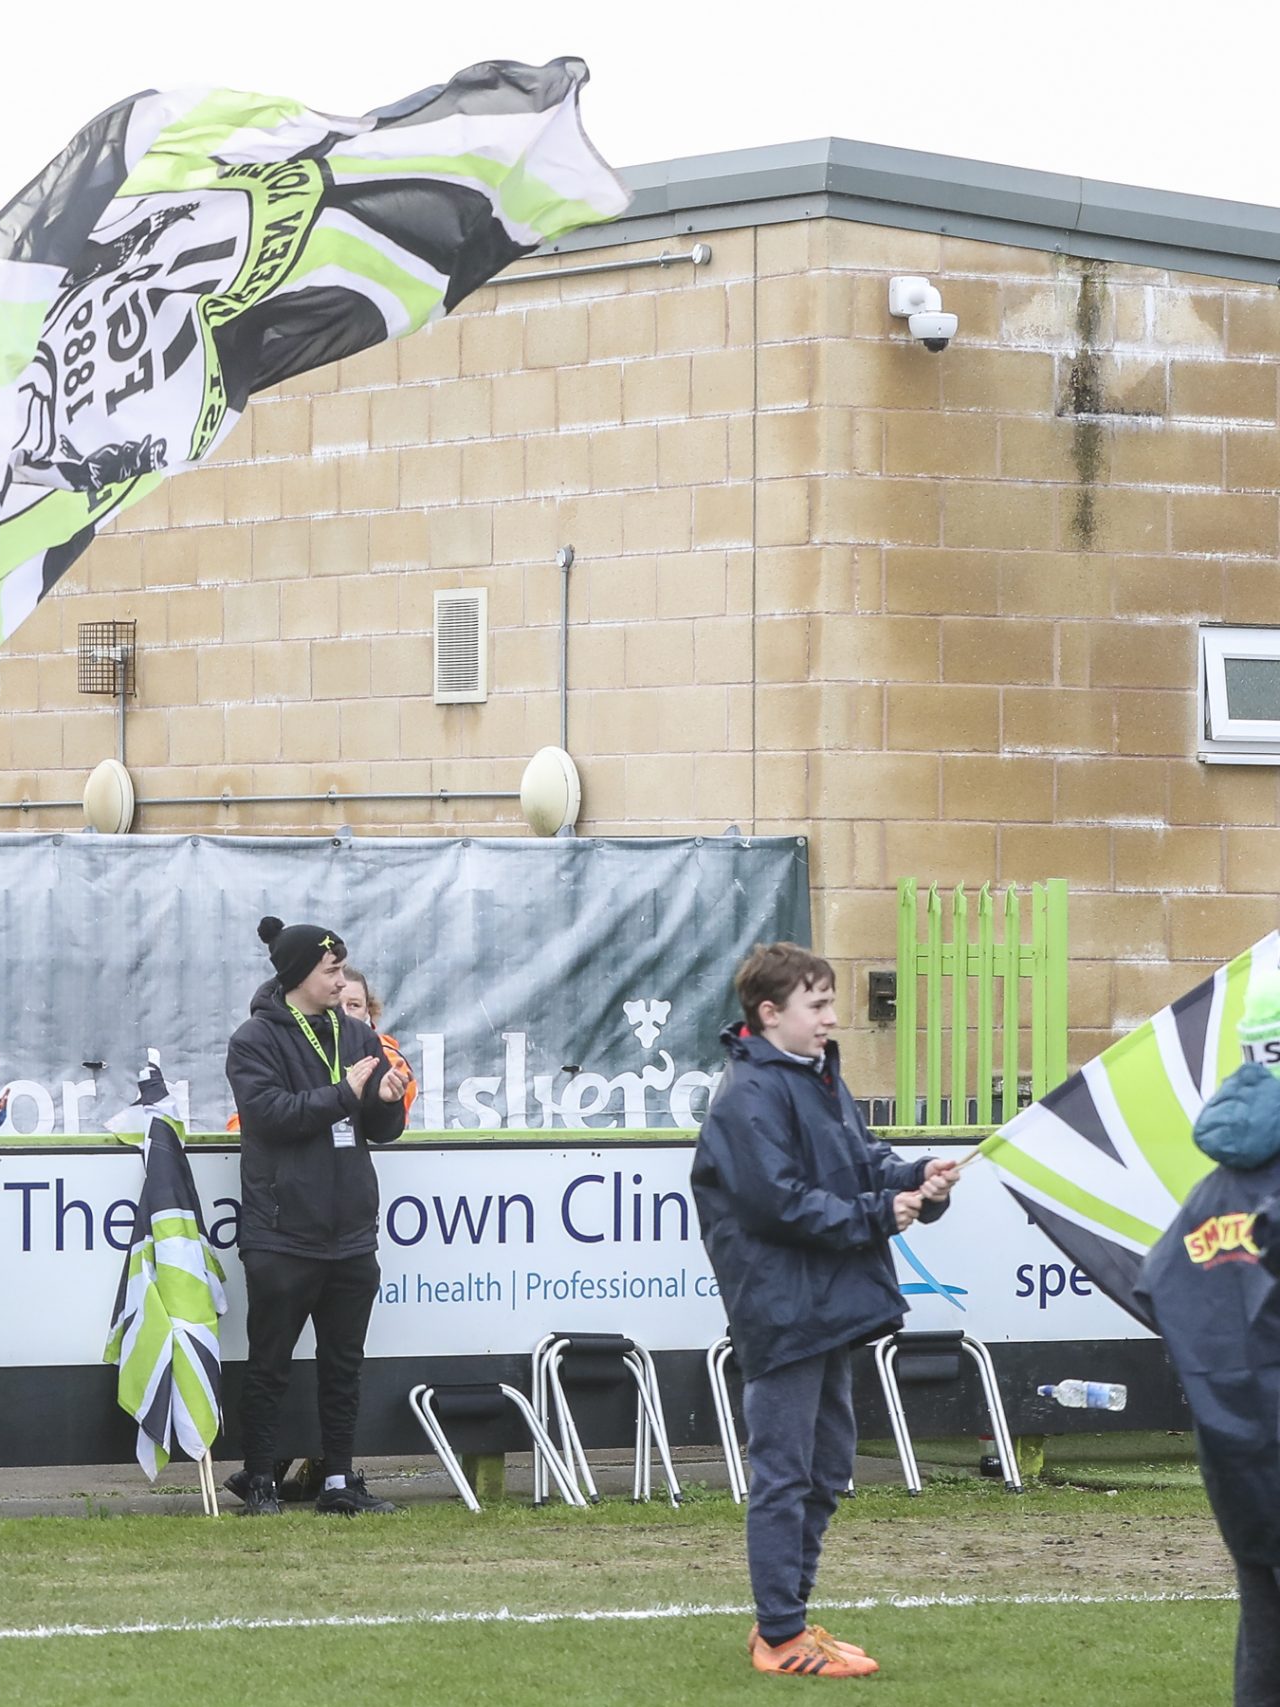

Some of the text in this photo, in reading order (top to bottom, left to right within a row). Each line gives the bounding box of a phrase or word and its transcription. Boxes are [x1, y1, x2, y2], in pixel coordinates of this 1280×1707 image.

[3, 1178, 141, 1252] The
[560, 1170, 690, 1244] Clin
[417, 1271, 502, 1304] health
[526, 1268, 686, 1301] Professional
[694, 1275, 721, 1298] ca
[1015, 1263, 1093, 1310] spe
